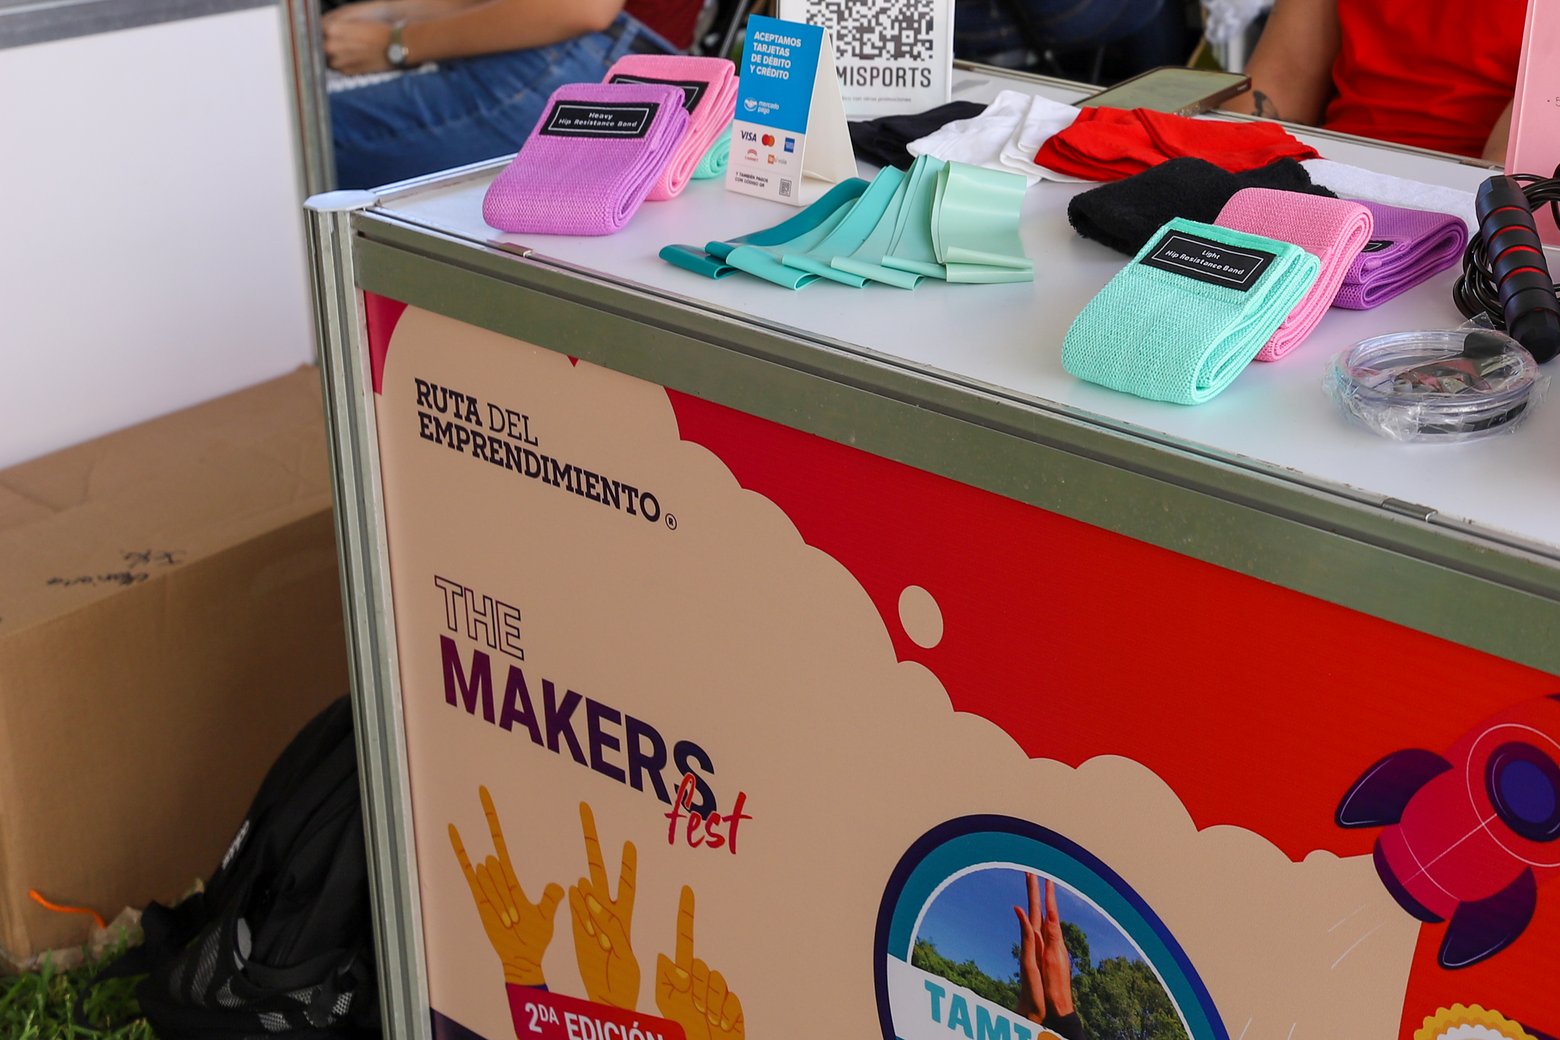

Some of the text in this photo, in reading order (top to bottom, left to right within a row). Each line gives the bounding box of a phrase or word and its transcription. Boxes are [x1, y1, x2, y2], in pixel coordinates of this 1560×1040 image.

[754, 31, 802, 48] ACEPTAMOS
[753, 42, 790, 57] TARJETAS
[751, 53, 792, 69] DE DÉBITO
[749, 64, 790, 80] Y CRÉDITO
[558, 117, 638, 129] Hip Resistance Band
[588, 111, 614, 121] Heavy
[740, 129, 757, 142] VISA
[1165, 249, 1245, 276] Hip Resistance Band
[1202, 249, 1221, 260] Light
[414, 377, 539, 447] RUTA DEL
[418, 411, 662, 524] EMPRENDIMIENTO
[434, 575, 524, 660] THE
[439, 634, 718, 821] MAKERS
[664, 772, 753, 854] fest
[564, 1012, 665, 1040] EDICIÓ
